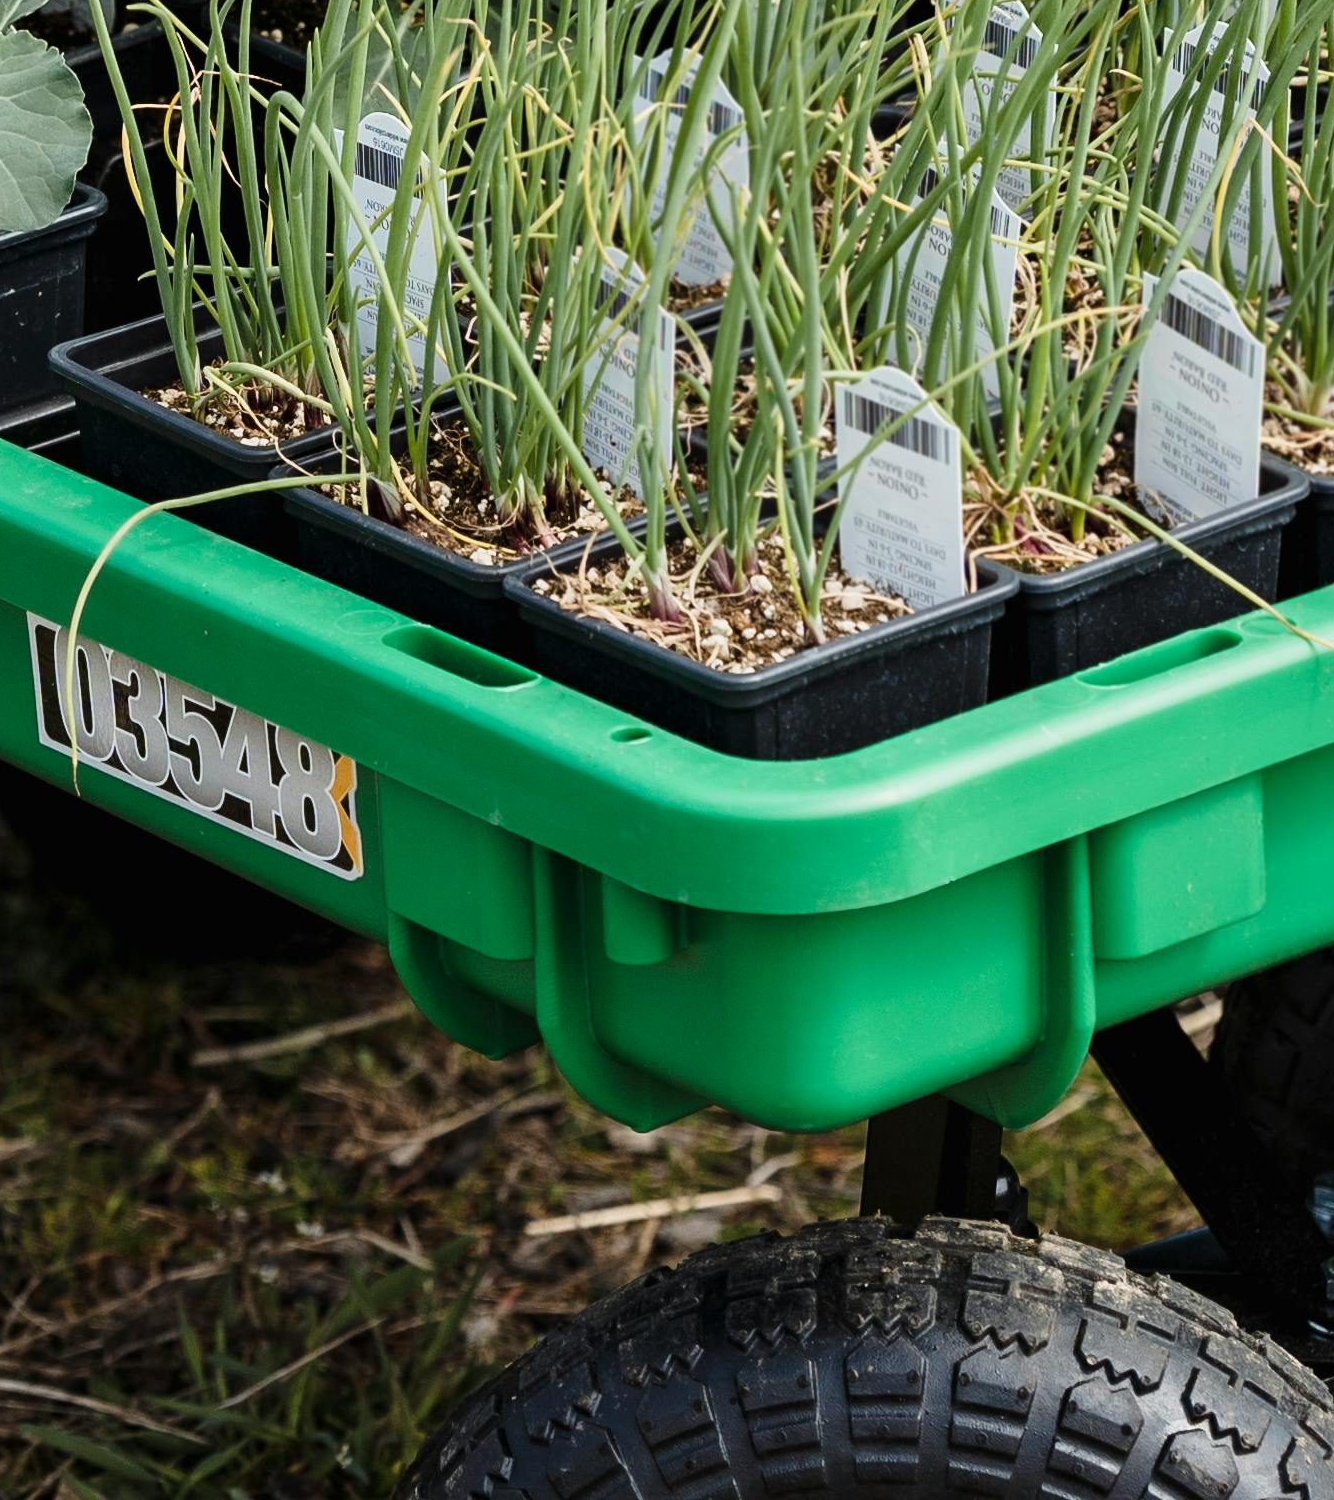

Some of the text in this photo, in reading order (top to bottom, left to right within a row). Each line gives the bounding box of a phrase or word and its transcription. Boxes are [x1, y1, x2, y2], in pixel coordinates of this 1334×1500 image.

[1207, 437, 1219, 451] TO
[1162, 456, 1178, 473] SUN
[1179, 467, 1197, 486] FULL
[910, 539, 922, 552] TO
[54, 624, 342, 861] 03548
